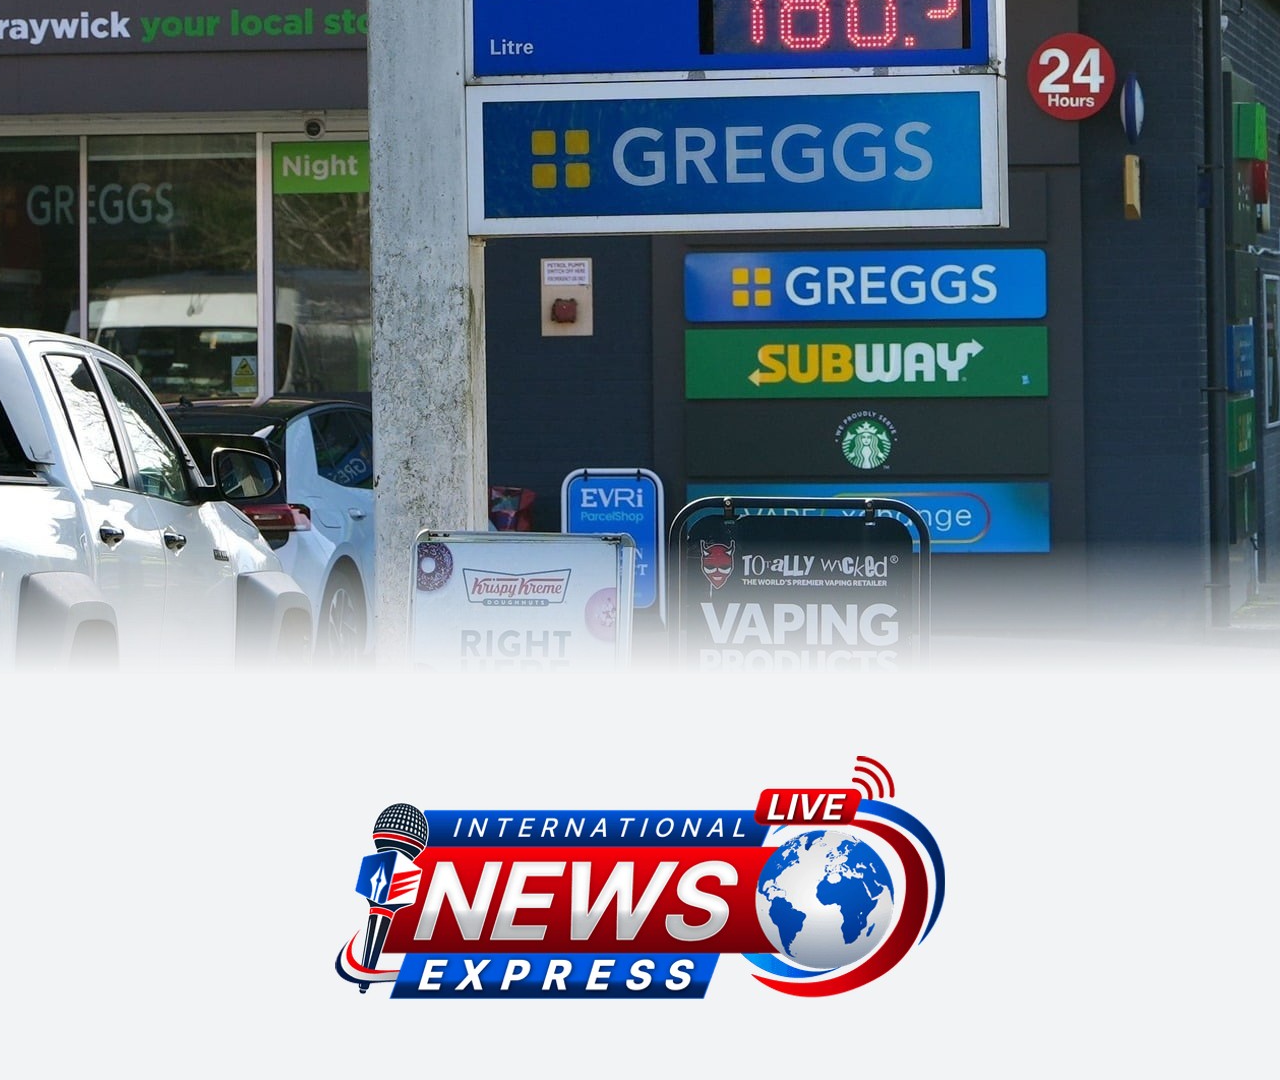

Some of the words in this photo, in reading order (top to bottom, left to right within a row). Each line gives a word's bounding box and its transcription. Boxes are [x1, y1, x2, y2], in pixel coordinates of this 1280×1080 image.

[141, 15, 220, 43] your
[230, 8, 313, 36] local
[489, 38, 535, 56] Litre
[1038, 47, 1105, 93] 24
[1047, 93, 1095, 107] Hours
[281, 154, 358, 181] Night
[612, 121, 933, 187] GREGGS
[785, 264, 998, 306] GREGGS
[748, 338, 985, 388] SUBWAY
[580, 488, 644, 508] EVRi
[580, 511, 644, 524] ParcelShop
[471, 577, 519, 597] Krispy
[518, 577, 564, 595] Kreme
[792, 579, 824, 587] PREMIER
[824, 579, 853, 587] VAPING
[700, 602, 900, 647] VAPING
[461, 629, 572, 658] RIGHT
